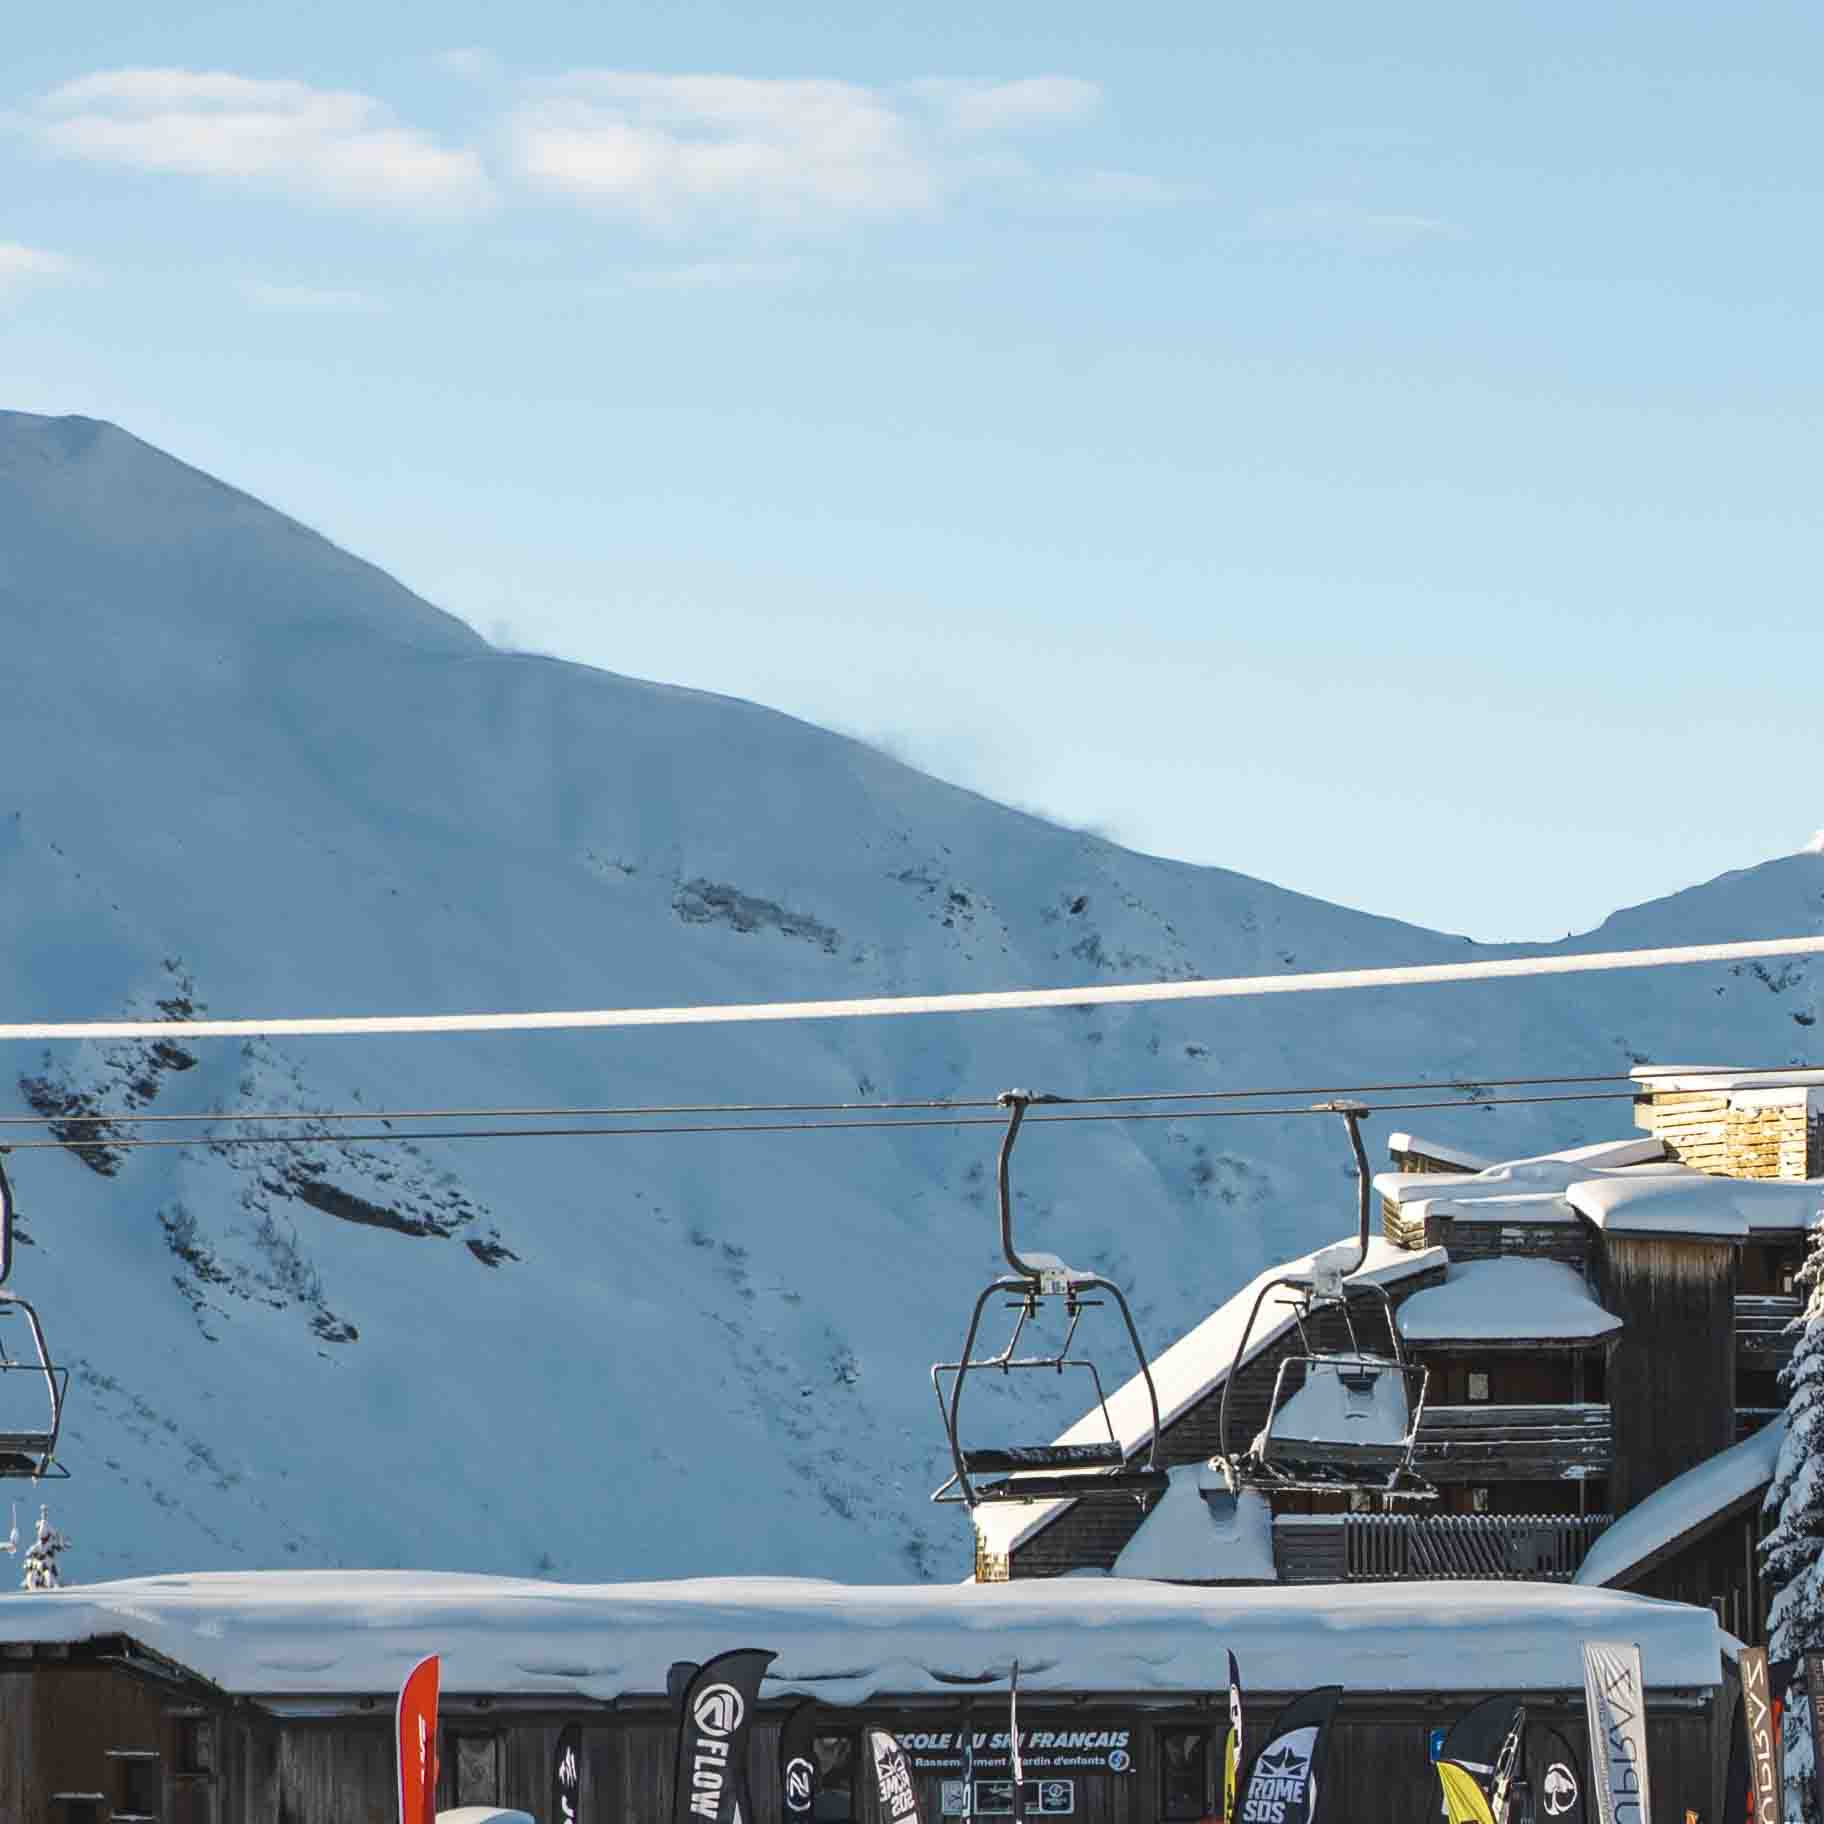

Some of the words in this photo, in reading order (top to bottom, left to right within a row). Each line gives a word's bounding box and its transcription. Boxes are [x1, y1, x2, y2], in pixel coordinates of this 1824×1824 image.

[1029, 1731, 1129, 1751] FRANÇAIS
[1053, 1756, 1105, 1768] d'enfants
[690, 1738, 729, 1822] FLOW
[1247, 1778, 1304, 1803] ROME
[1242, 1801, 1286, 1824] SDS
